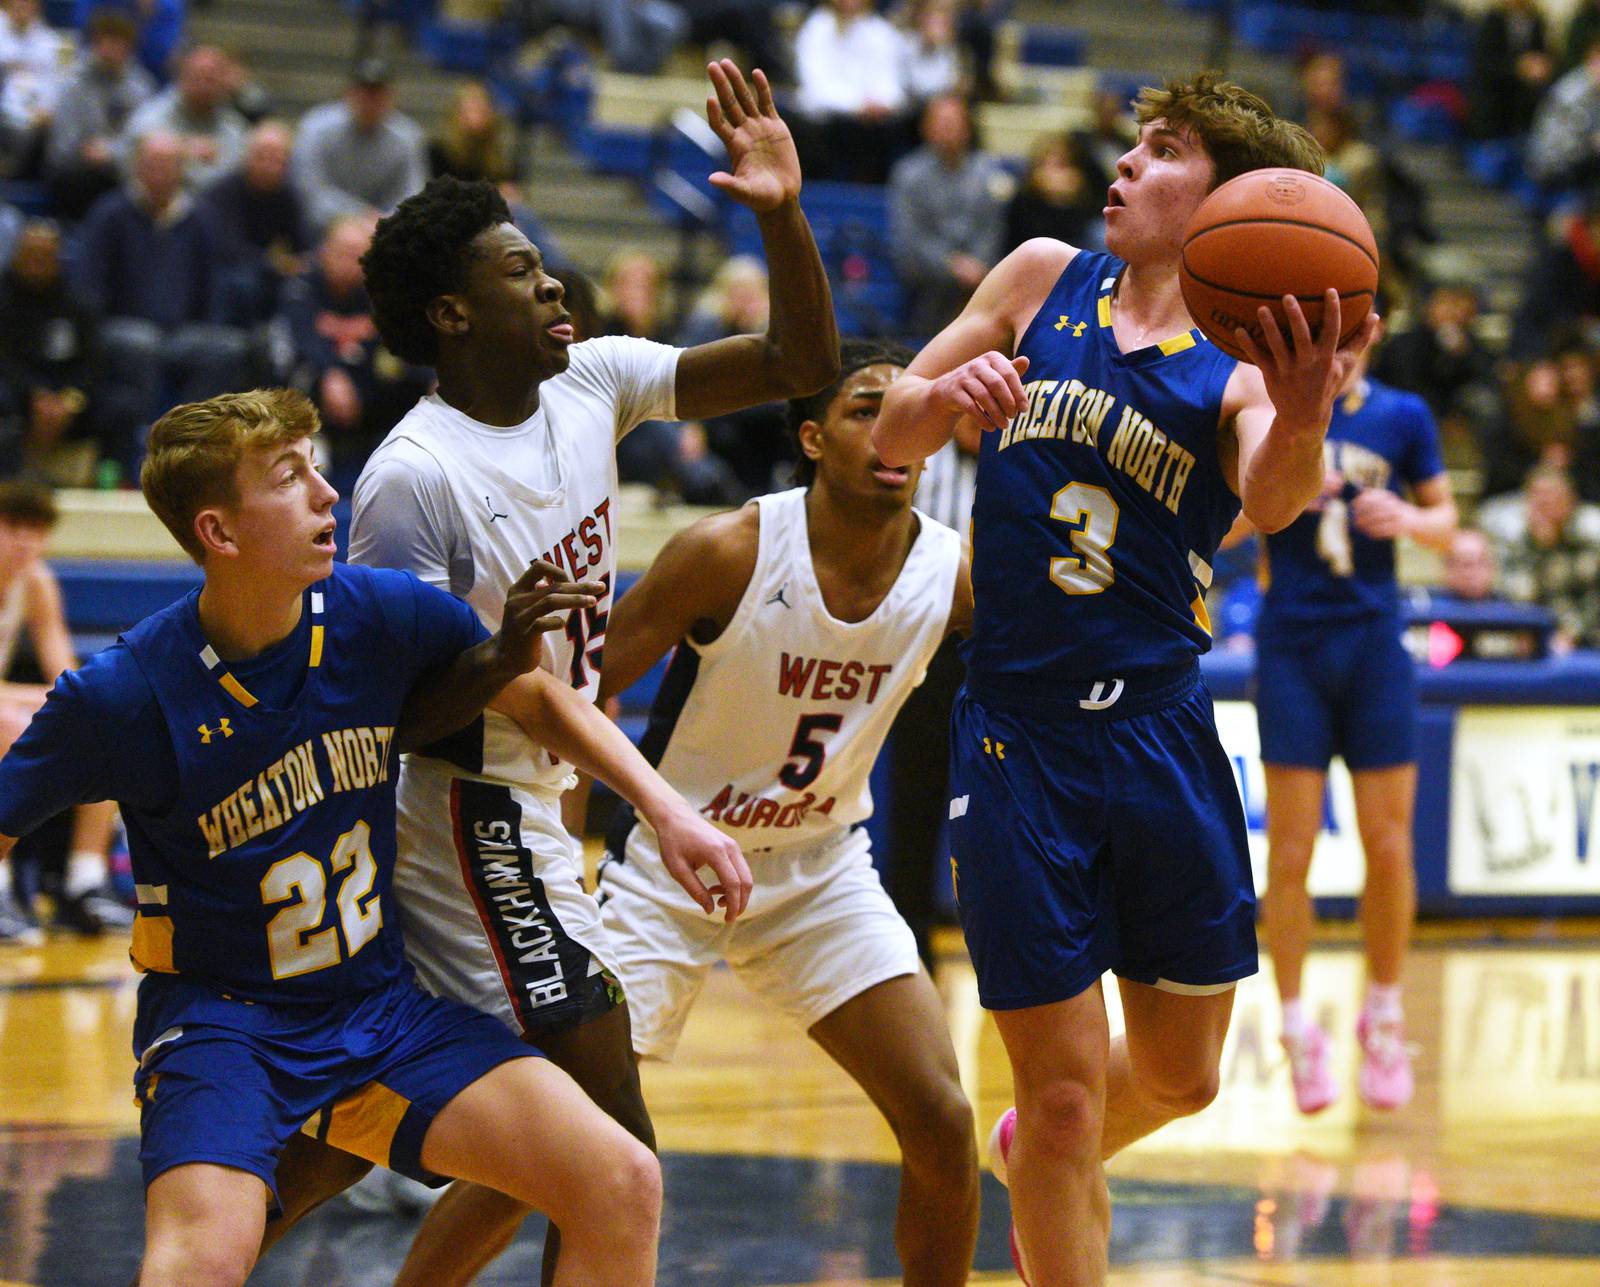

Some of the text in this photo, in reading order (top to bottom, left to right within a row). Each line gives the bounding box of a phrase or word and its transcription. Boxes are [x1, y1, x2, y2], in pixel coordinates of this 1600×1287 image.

[1106, 404, 1197, 517] NORTH
[1049, 480, 1120, 595] 3
[778, 652, 893, 704] WEST
[198, 726, 396, 860] WHEATON NORT
[778, 713, 844, 792] 5
[260, 819, 383, 980] 22
[474, 820, 568, 1009] BLACKHAWKS
